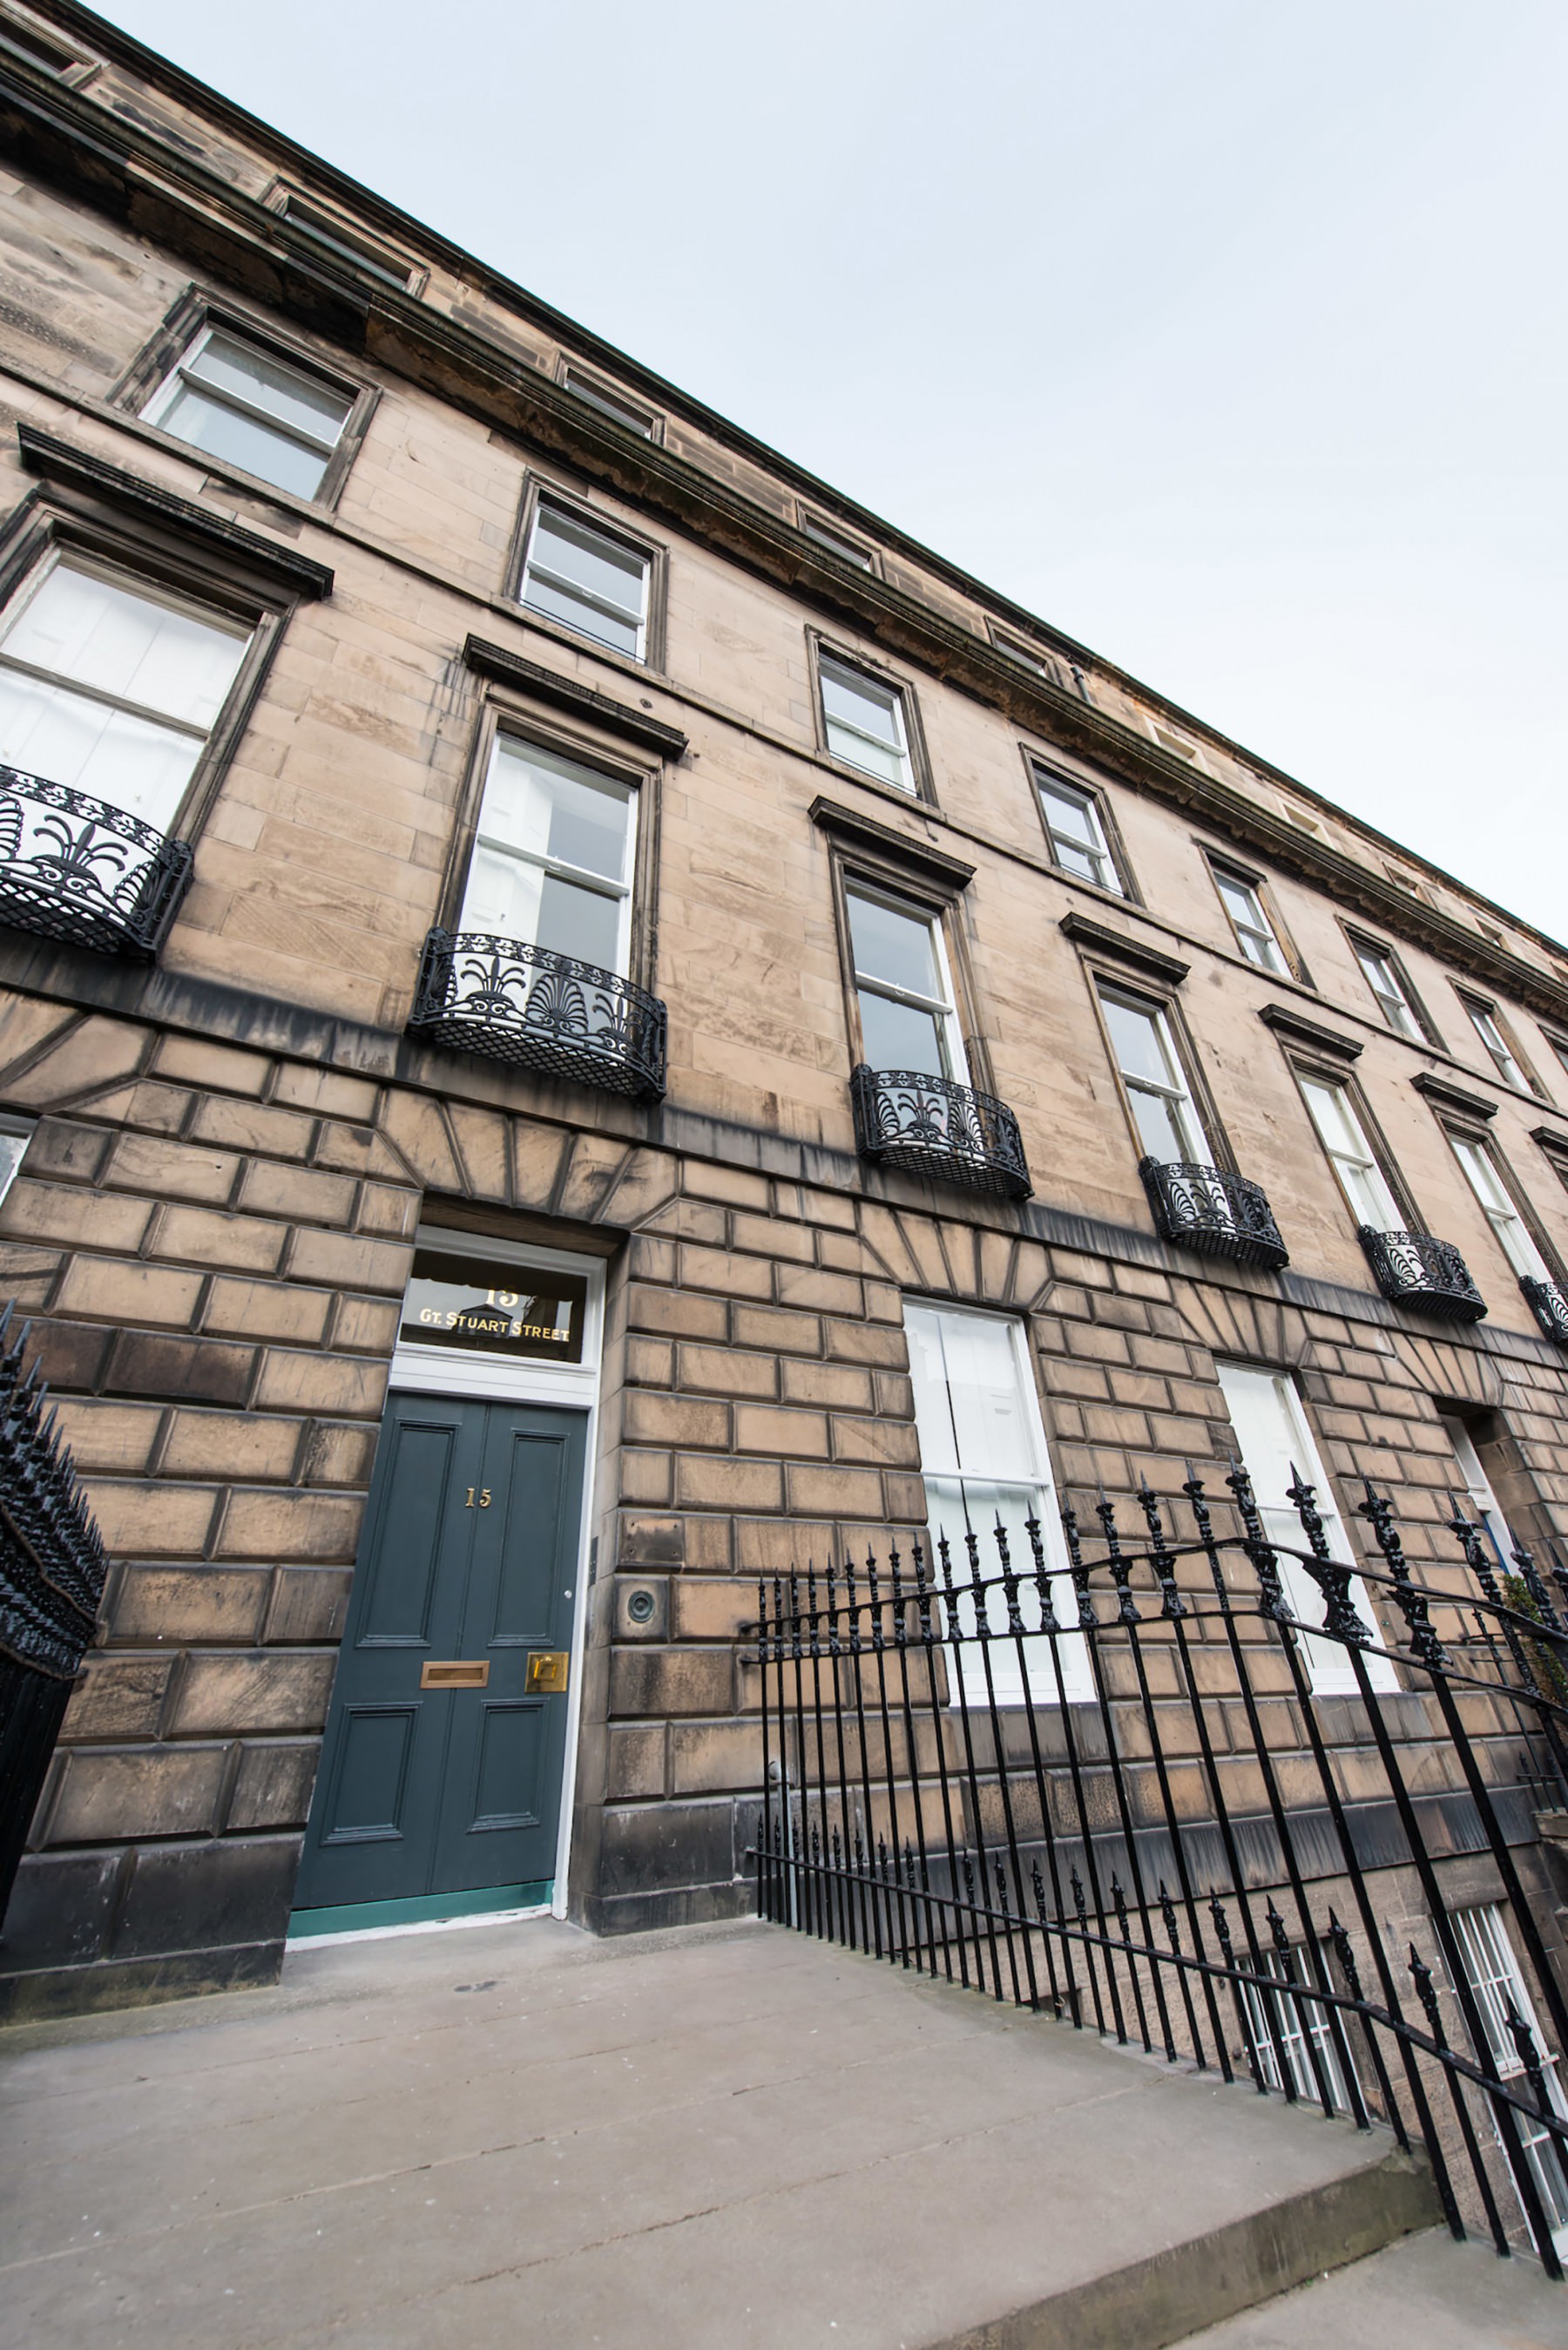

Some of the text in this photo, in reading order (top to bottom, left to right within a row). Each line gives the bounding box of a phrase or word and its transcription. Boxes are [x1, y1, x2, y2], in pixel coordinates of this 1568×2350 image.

[445, 1311, 509, 1333] STUART
[511, 1321, 570, 1343] STREET
[465, 1487, 492, 1508] 15
